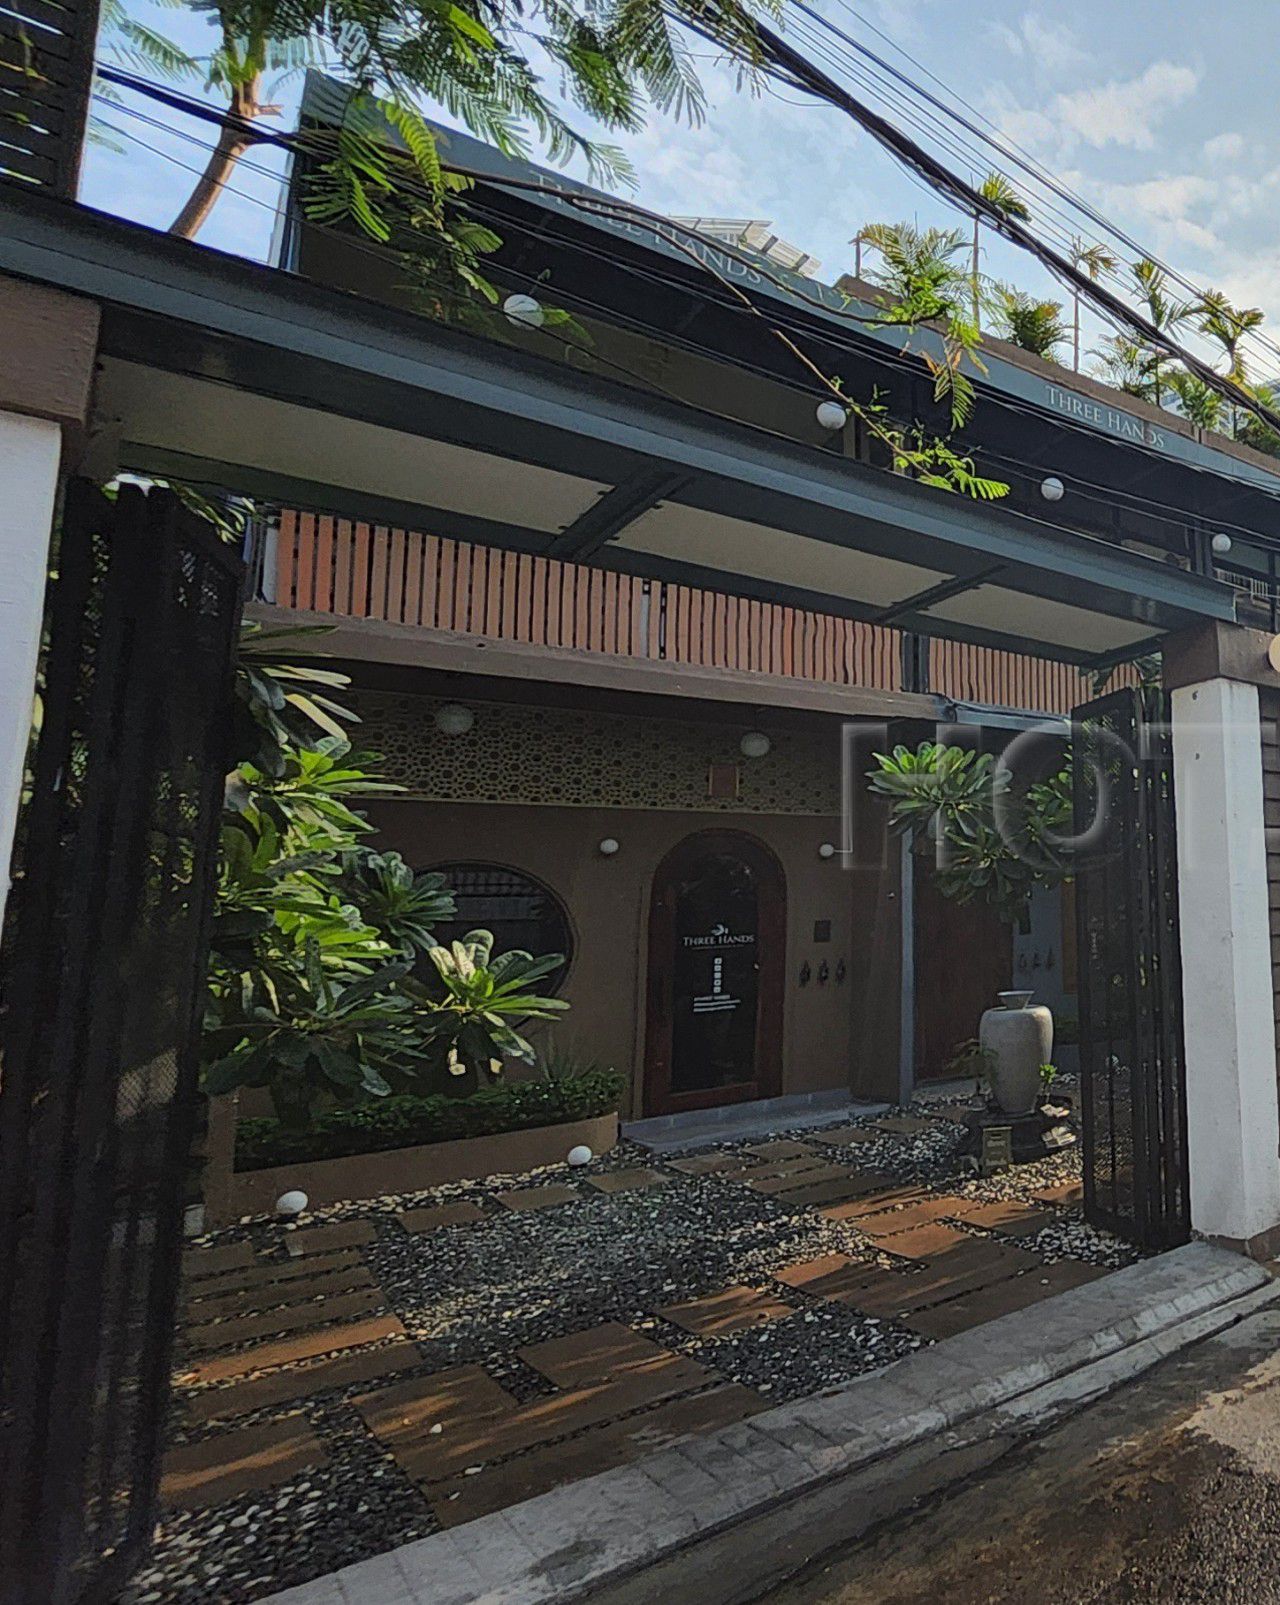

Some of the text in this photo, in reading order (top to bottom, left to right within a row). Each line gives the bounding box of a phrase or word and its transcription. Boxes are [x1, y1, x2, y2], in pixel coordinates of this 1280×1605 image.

[1045, 385, 1104, 423] THREE
[683, 934, 755, 946] THREE HANDS
